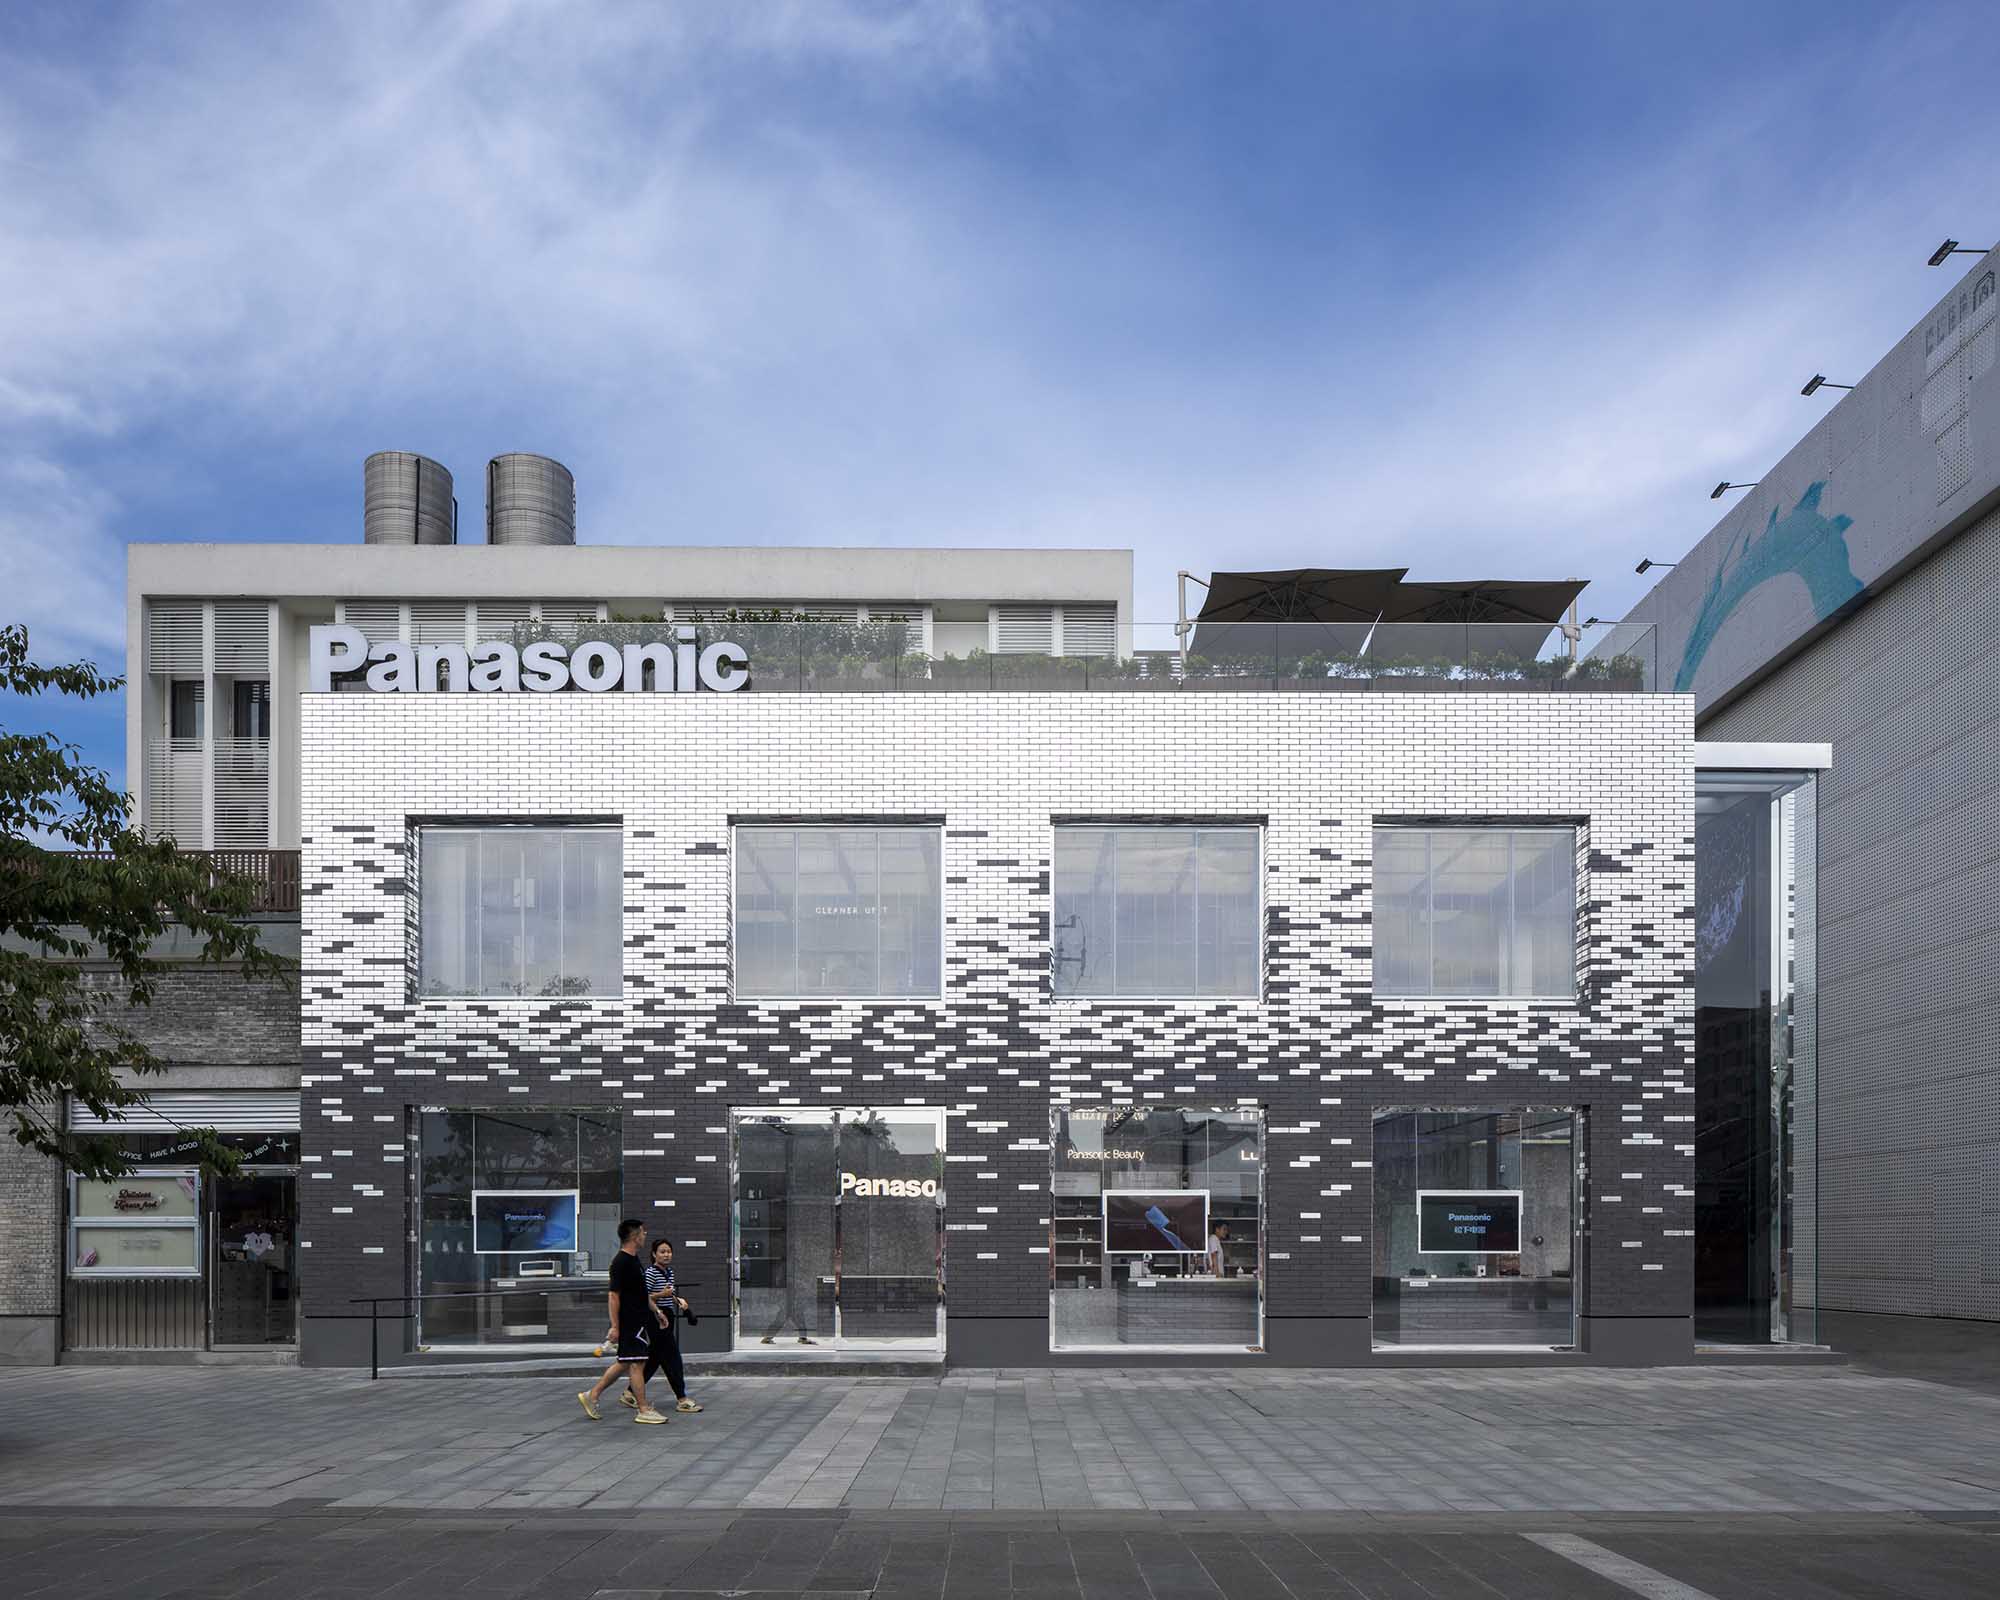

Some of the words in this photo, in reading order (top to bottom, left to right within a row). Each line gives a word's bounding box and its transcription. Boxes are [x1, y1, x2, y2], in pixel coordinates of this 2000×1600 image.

[310, 625, 748, 691] Panasonic
[150, 1148, 168, 1159] HAVE
[170, 1146, 176, 1154] A
[1067, 1149, 1109, 1159] Panasonic
[1112, 1149, 1145, 1161] Beauty
[841, 1172, 937, 1197] Panaso
[504, 1213, 546, 1221] Panasonic
[1448, 1213, 1492, 1221] Panasonic
